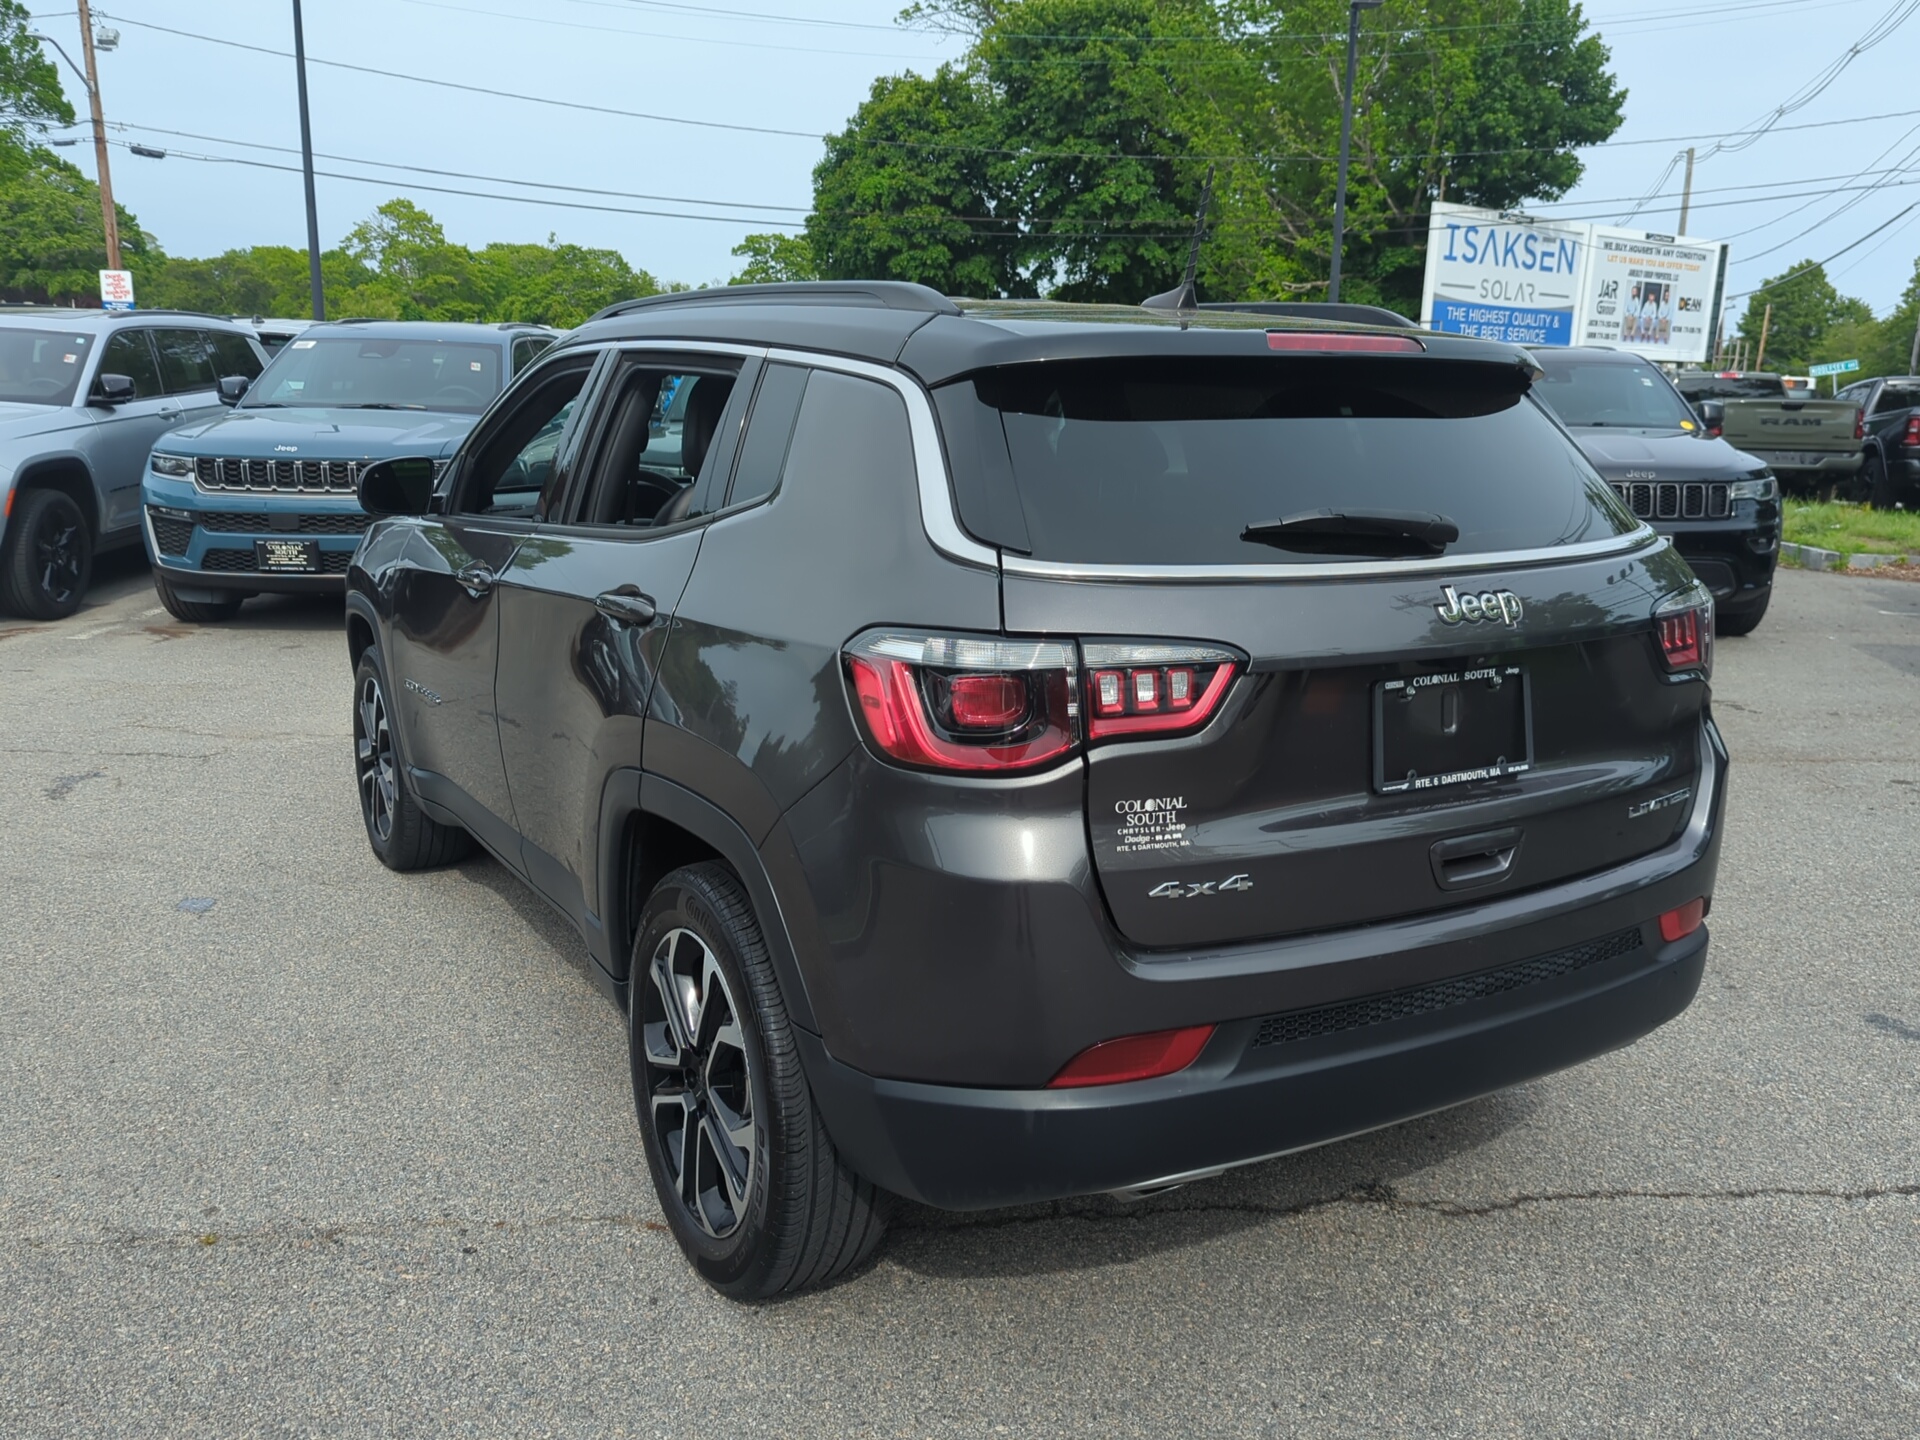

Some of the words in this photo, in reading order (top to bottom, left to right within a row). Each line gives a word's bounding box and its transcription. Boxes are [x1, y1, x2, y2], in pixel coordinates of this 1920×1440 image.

[1443, 223, 1577, 275] ISAKSEN
[1603, 241, 1613, 250] WE
[1614, 242, 1628, 251] BUY
[1629, 244, 1653, 254] HOUSES
[1654, 247, 1661, 256] IN
[1662, 249, 1674, 257] ANY
[1675, 250, 1707, 261] CONDITION
[1666, 261, 1683, 270] OFFER
[1479, 278, 1535, 303] SOLAR
[1678, 296, 1702, 311] DEAN
[1447, 306, 1466, 321] THE
[1468, 309, 1510, 324] HIGHEST
[1512, 312, 1551, 327] QUALITY
[1552, 315, 1560, 328] &
[1459, 324, 1479, 337] THE
[1480, 325, 1505, 341] BEST
[1507, 327, 1547, 343] SERVICE
[1761, 417, 1822, 427] RAM
[274, 444, 298, 452] Jeep
[1626, 469, 1656, 480] Jeep
[1434, 585, 1523, 628] Jeep
[1413, 673, 1460, 687] COLONIAL
[1464, 668, 1496, 680] SOUTH
[1505, 667, 1520, 675] Jeep
[1415, 778, 1433, 789] RTE.
[1433, 777, 1438, 786] 6
[1441, 769, 1489, 784] DARTMOUTH,
[1489, 767, 1501, 776] MA
[1115, 796, 1188, 814] COLONIAL
[1126, 810, 1177, 827] SOUTH
[1117, 826, 1161, 835] CHRYSLER
[1165, 823, 1186, 831] Jeep
[1124, 834, 1151, 844] Dodge
[1155, 833, 1182, 841] RAM
[1137, 841, 1179, 850] DARTMOUTH,
